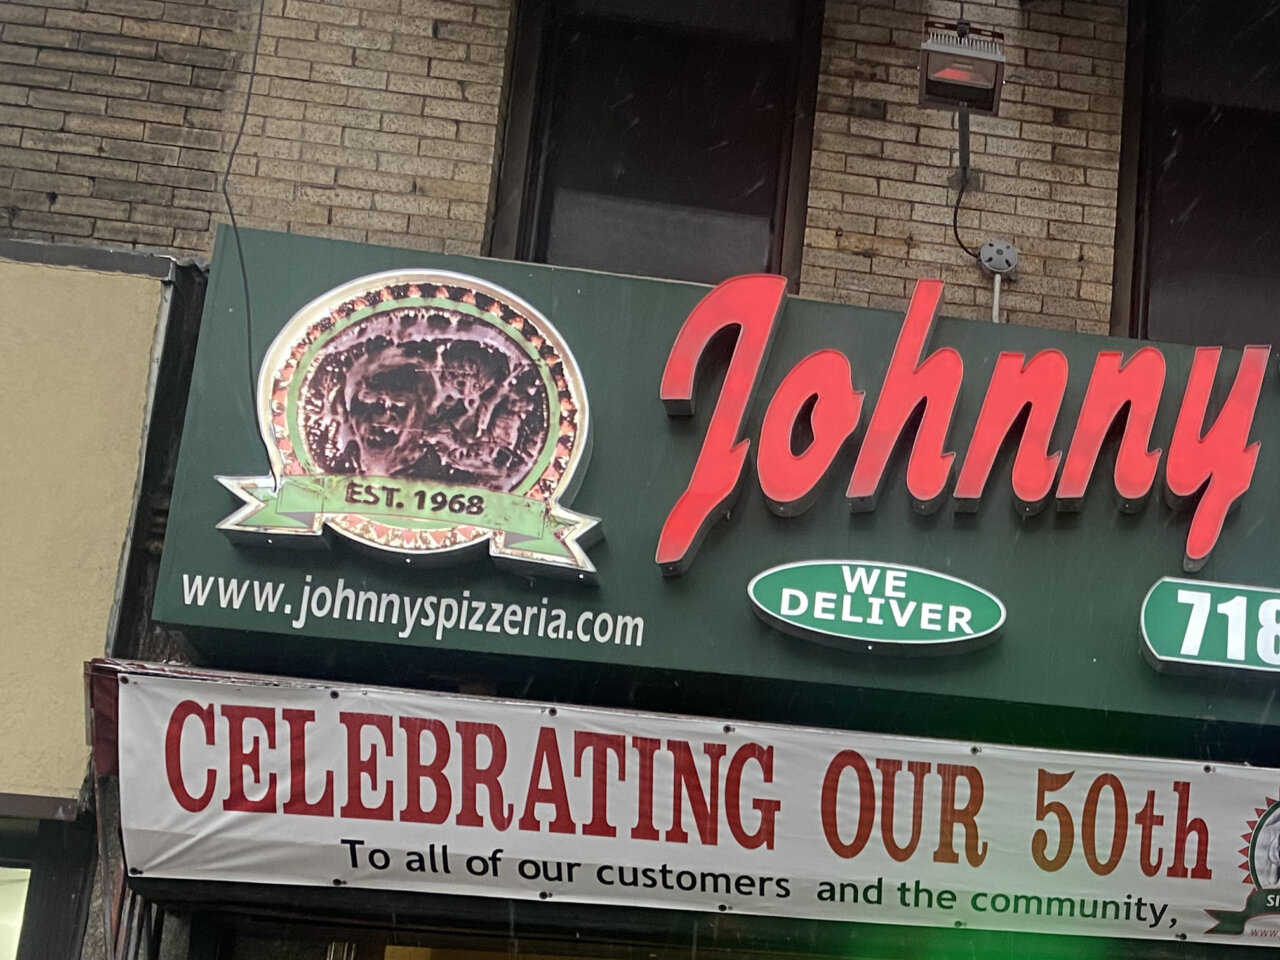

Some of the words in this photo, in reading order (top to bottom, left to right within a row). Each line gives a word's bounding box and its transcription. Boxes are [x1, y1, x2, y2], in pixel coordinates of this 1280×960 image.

[344, 480, 404, 511] EST.
[412, 489, 486, 516] 1968
[181, 572, 646, 648] www.johnnyspizzeria.com
[779, 588, 974, 635] DELIVER
[840, 563, 909, 599] WE
[164, 699, 782, 851] CELEBRATING
[820, 748, 988, 868] OUR
[1031, 767, 1213, 882] 50th
[340, 838, 391, 871] To
[405, 843, 452, 875] all
[465, 847, 503, 879] of
[517, 859, 582, 884] our
[596, 861, 792, 900] customers
[816, 876, 884, 906] and
[897, 879, 958, 911] the
[970, 890, 1180, 930] community,
